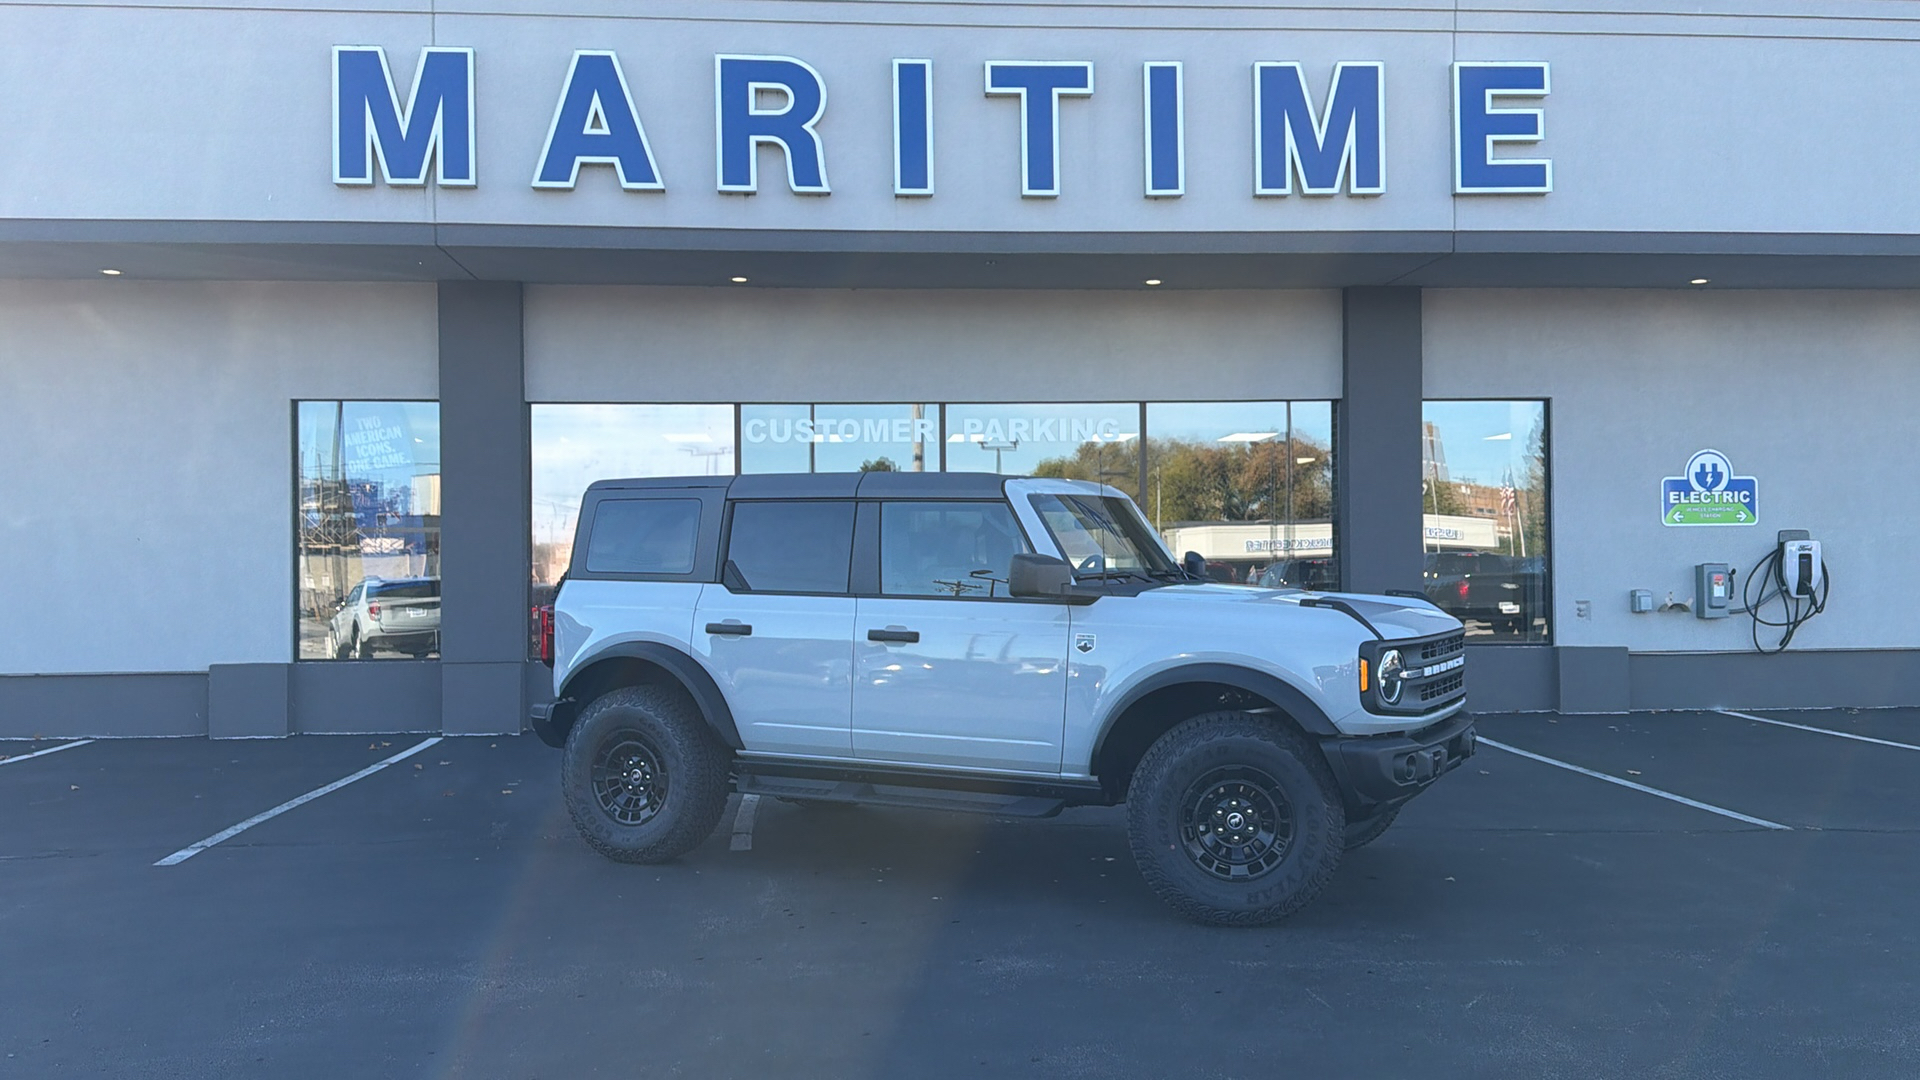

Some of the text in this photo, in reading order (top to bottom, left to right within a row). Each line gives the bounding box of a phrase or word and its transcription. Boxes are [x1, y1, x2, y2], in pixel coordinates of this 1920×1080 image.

[332, 44, 1553, 198] MARITIME
[355, 415, 381, 430] TWO
[745, 418, 1120, 442] CUSTOMER PARKING
[345, 425, 402, 447] AMERICAN
[356, 440, 396, 458] ICONS.
[348, 458, 372, 473] ONE
[1669, 491, 1751, 504] ELECTRIC
